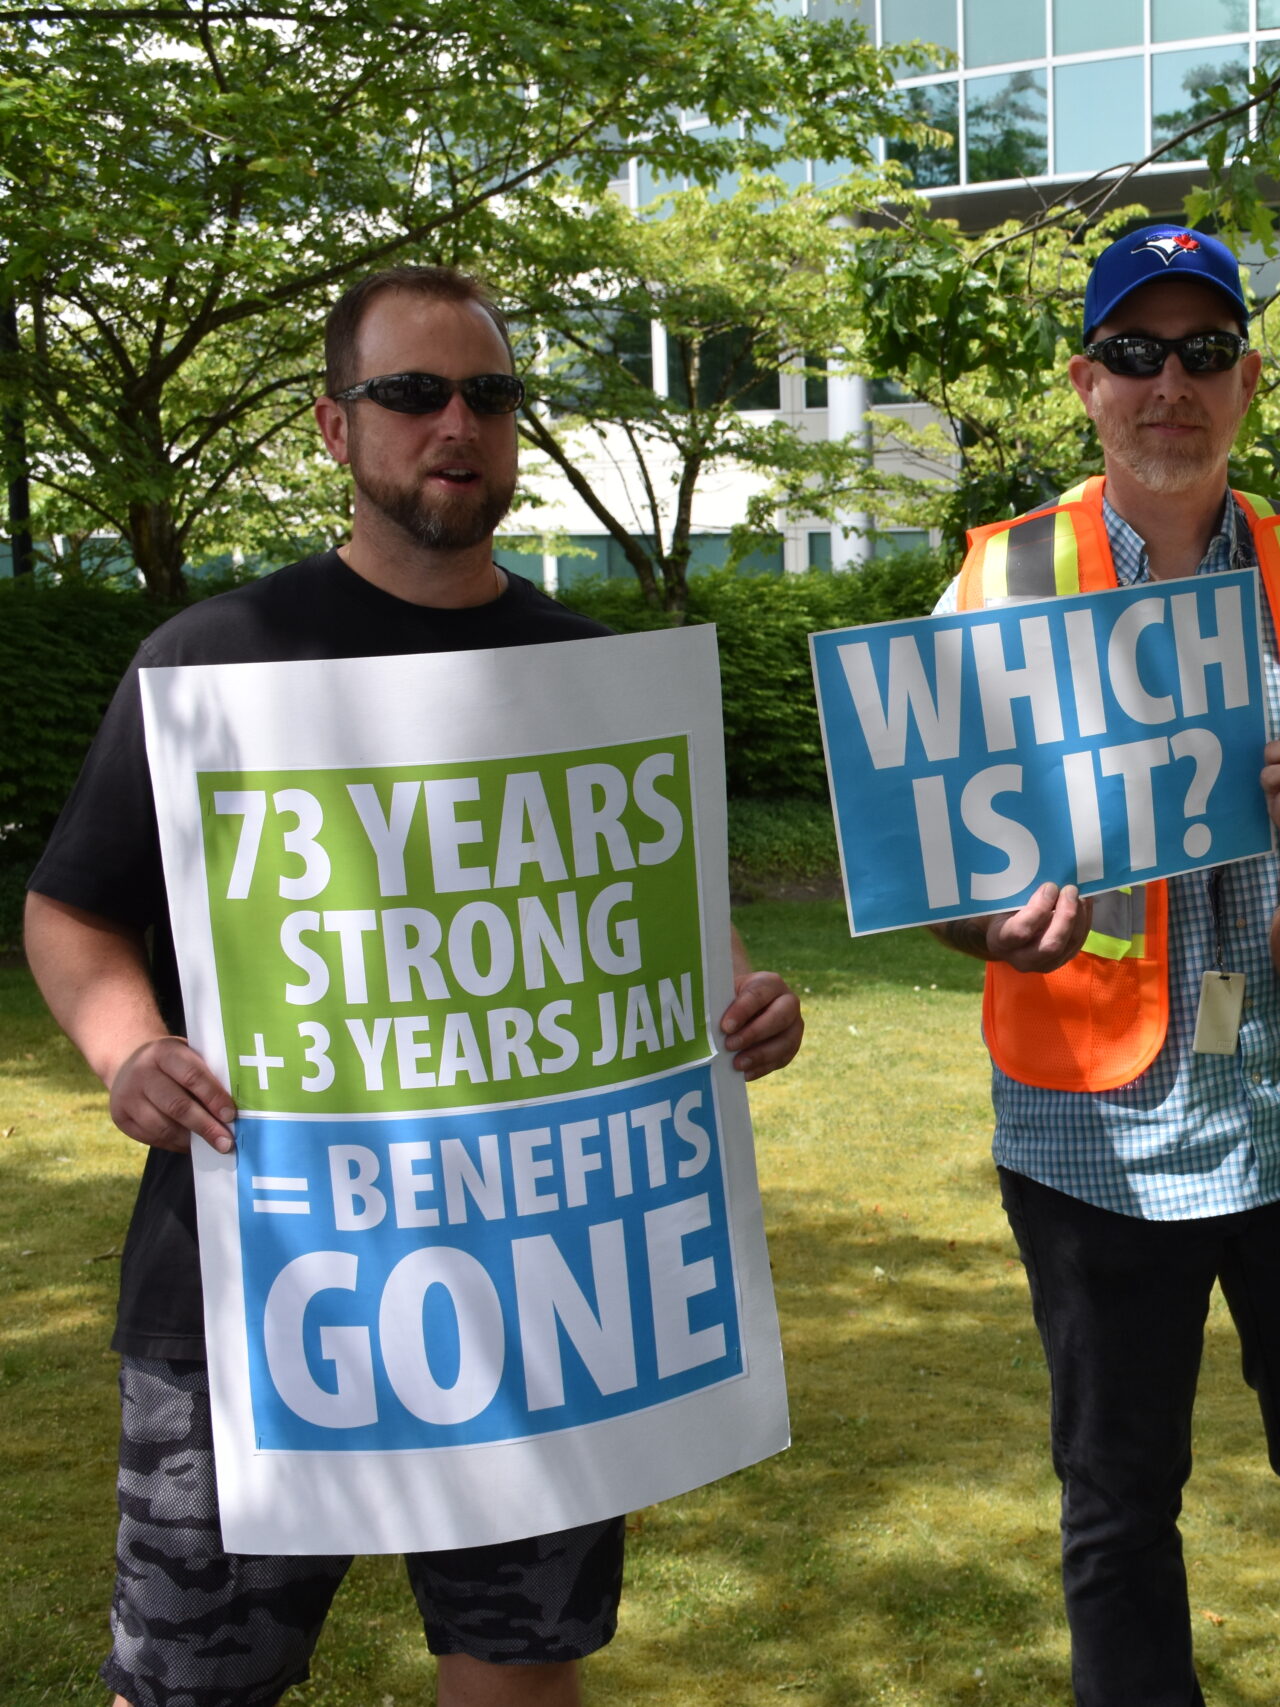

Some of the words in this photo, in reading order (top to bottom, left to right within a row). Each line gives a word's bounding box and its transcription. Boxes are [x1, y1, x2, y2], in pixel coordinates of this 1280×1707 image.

[837, 585, 1249, 770] WHICH
[214, 789, 331, 900] 73
[346, 753, 683, 897] YEARS
[912, 764, 1040, 909] IS
[1062, 728, 1223, 884] IT?
[279, 881, 641, 1005] STRONG
[299, 1021, 335, 1092] 3
[345, 1000, 580, 1091] YEARS
[591, 971, 696, 1066] JAN
[328, 1090, 711, 1231] BENEFITS
[264, 1192, 726, 1429] GONE
